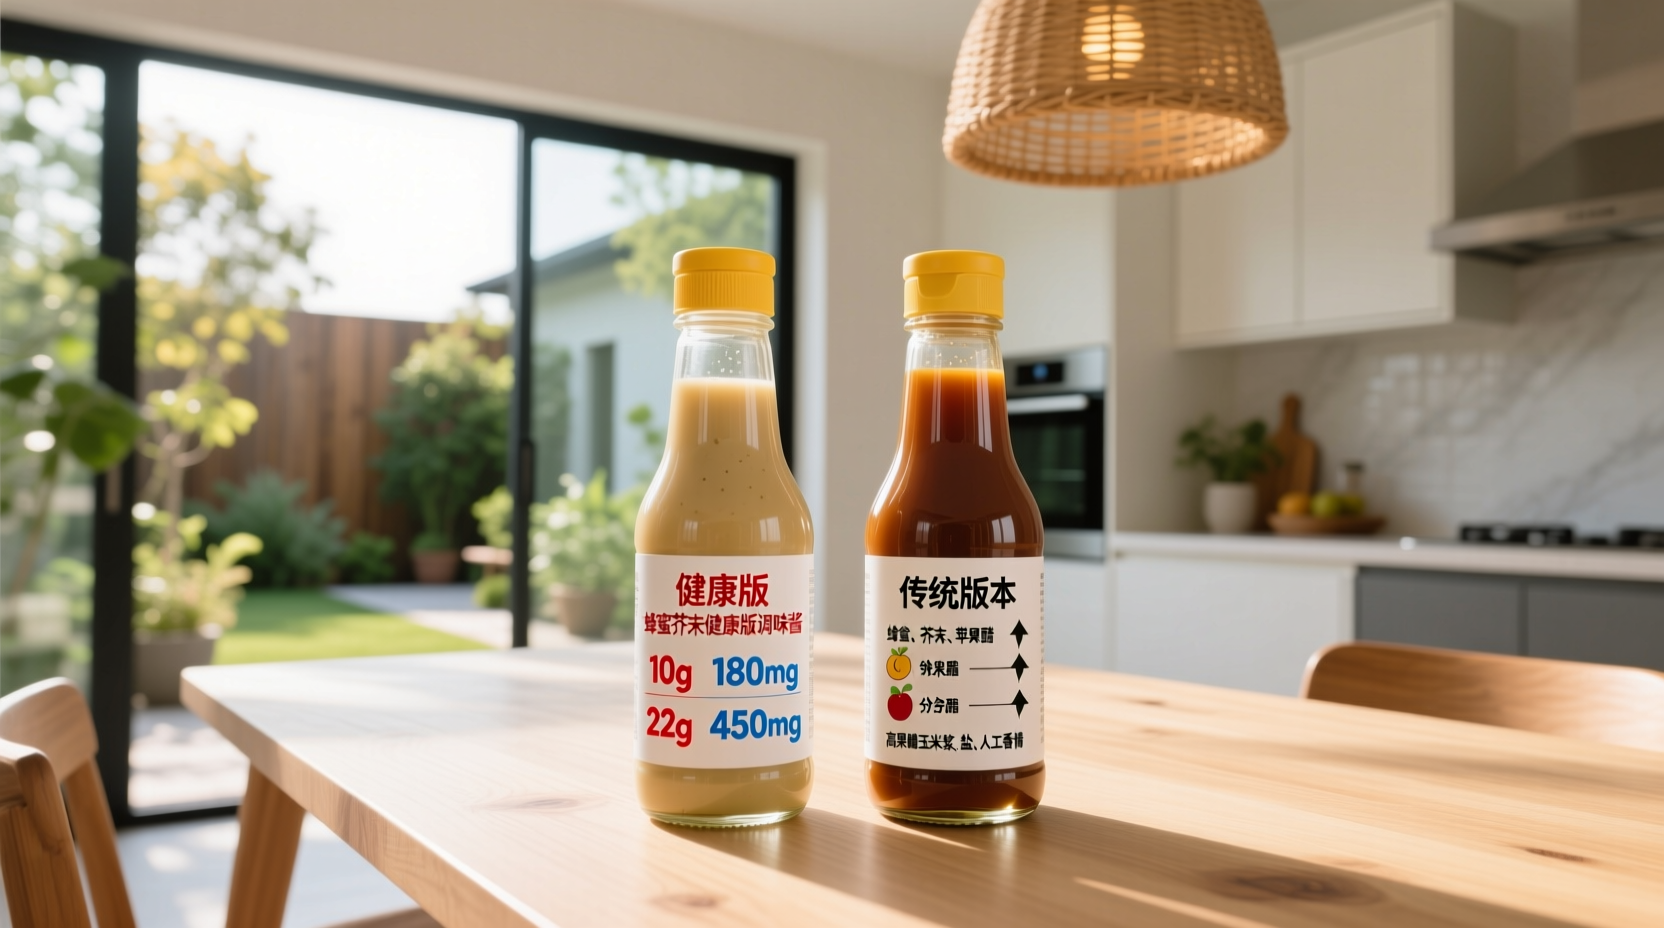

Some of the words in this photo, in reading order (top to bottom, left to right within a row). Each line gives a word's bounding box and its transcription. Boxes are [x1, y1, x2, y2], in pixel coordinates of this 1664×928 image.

[675, 572, 769, 607] 健康版
[899, 575, 1017, 610] 传统版本
[649, 654, 693, 694] 10g
[712, 656, 799, 692] 180mg
[646, 706, 693, 748] 22g
[709, 708, 802, 744] 450mg
